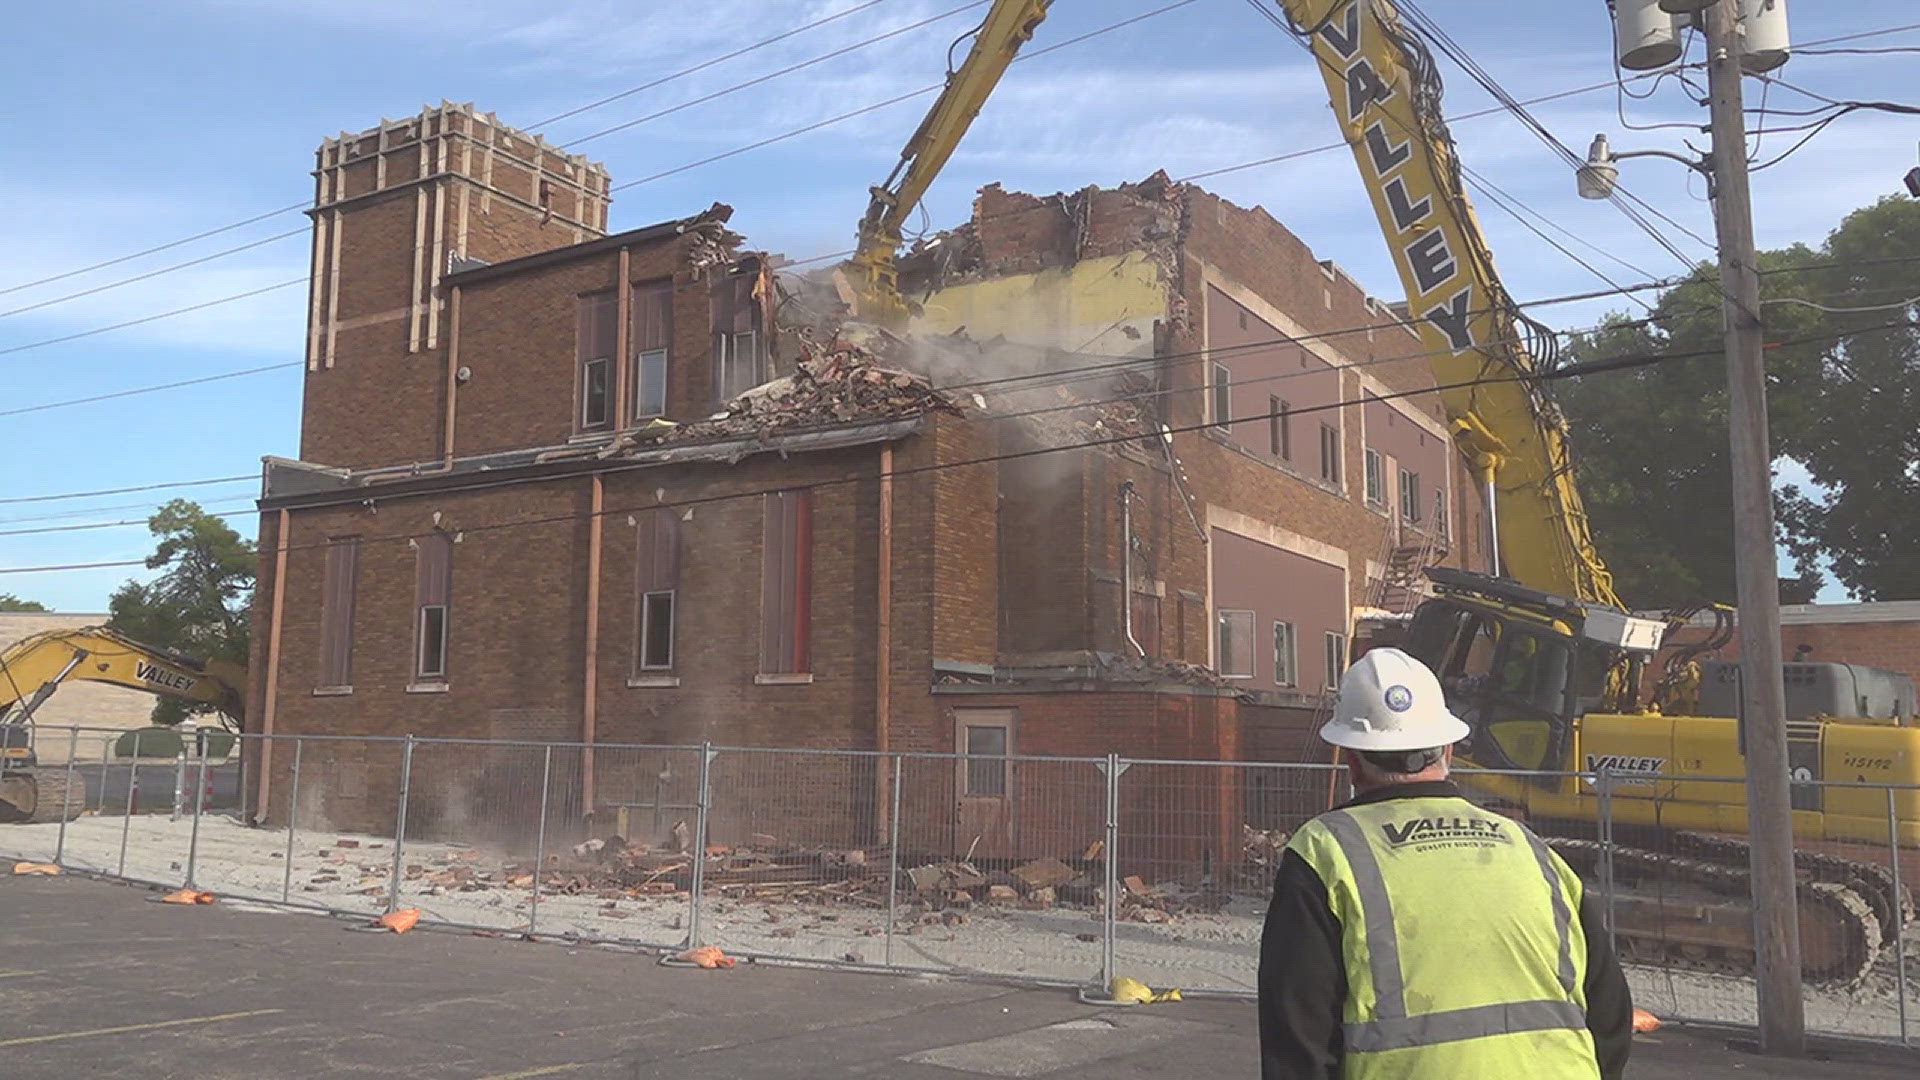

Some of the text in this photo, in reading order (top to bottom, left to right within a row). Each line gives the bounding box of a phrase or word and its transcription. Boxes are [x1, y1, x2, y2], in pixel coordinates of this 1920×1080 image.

[1319, 1, 1475, 355] VALLEY
[136, 660, 194, 690] VALLEY
[1586, 755, 1662, 773] VALLEY
[1382, 817, 1499, 844] VALLEY
